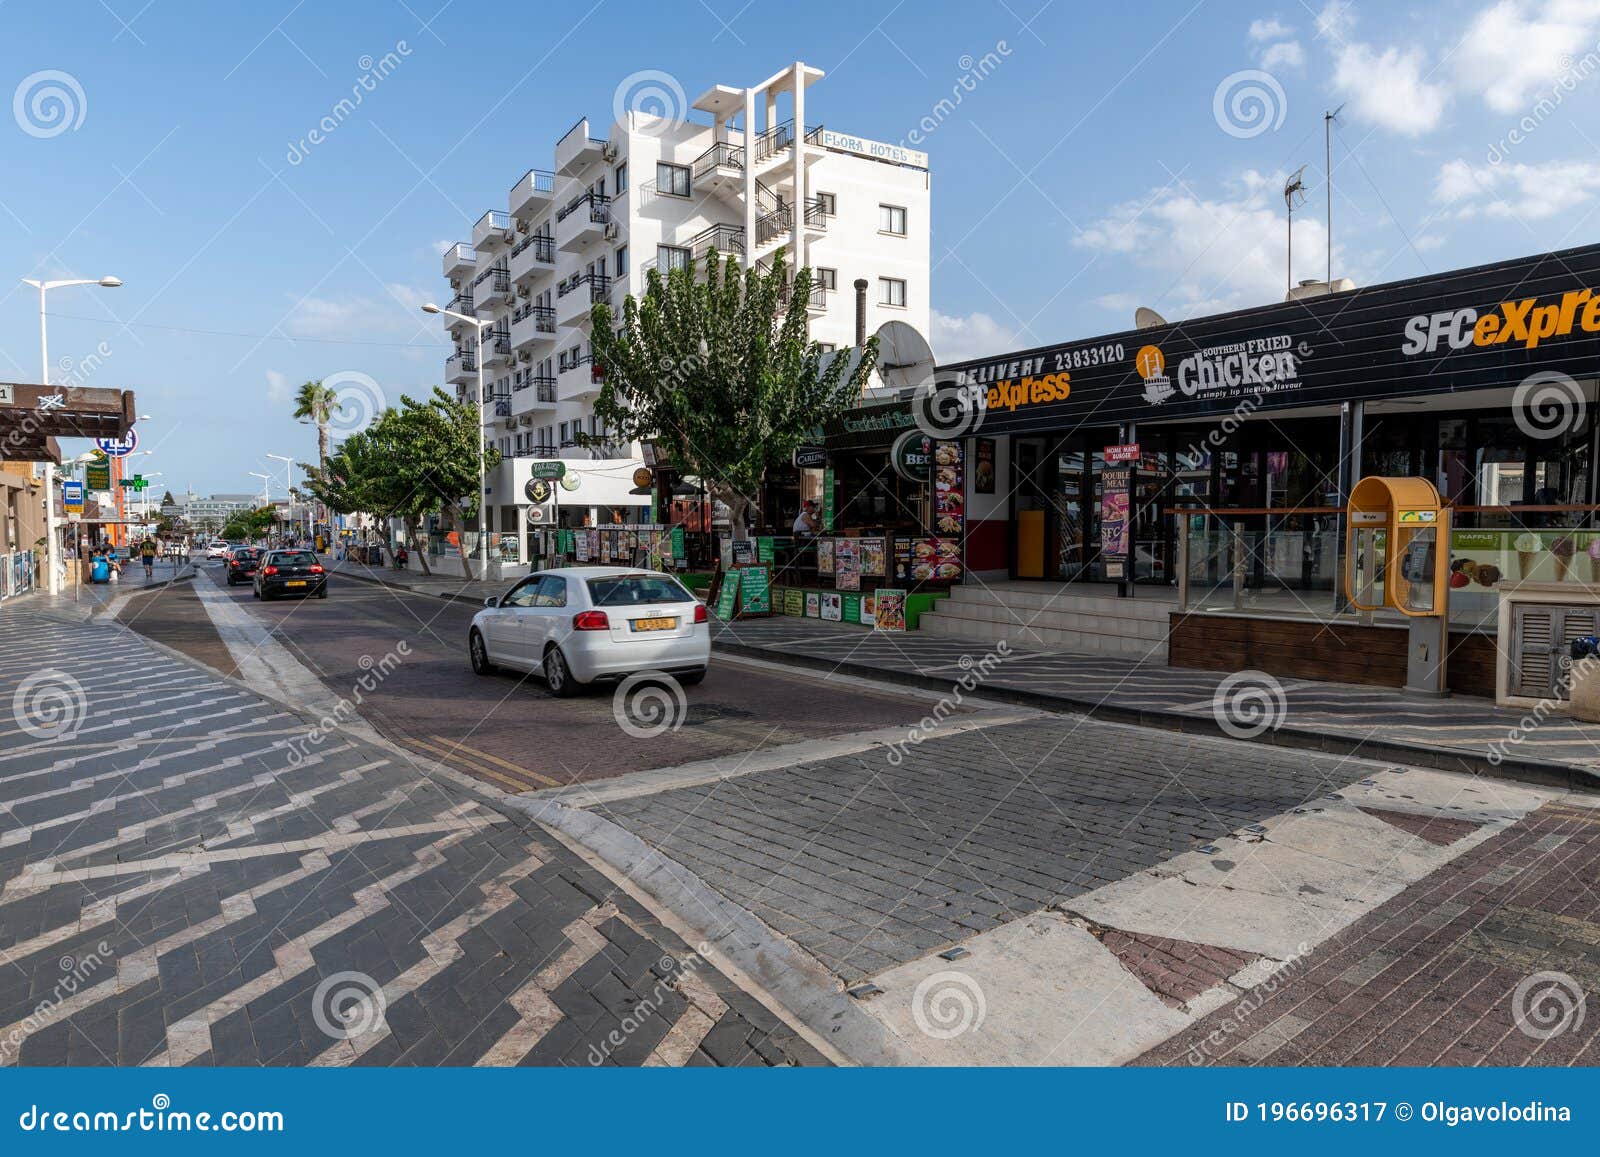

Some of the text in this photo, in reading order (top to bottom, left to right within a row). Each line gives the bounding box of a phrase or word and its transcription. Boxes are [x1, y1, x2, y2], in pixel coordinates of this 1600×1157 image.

[825, 133, 908, 162] FLORA HOTEL
[1203, 335, 1292, 358] SOUTHERN FRIED
[956, 343, 1124, 387] DELIVERY 23833120
[1203, 390, 1227, 399] simply
[1230, 388, 1240, 396] lip
[1274, 382, 1303, 391] flavour
[1123, 445, 1137, 453] MADE
[797, 451, 827, 466] CARLING
[1112, 452, 1132, 460] BURGER
[1102, 471, 1130, 480] DOUBLE
[1106, 480, 1128, 489] MEAL
[1101, 527, 1121, 538] SFC
[894, 542, 910, 550] THIS
